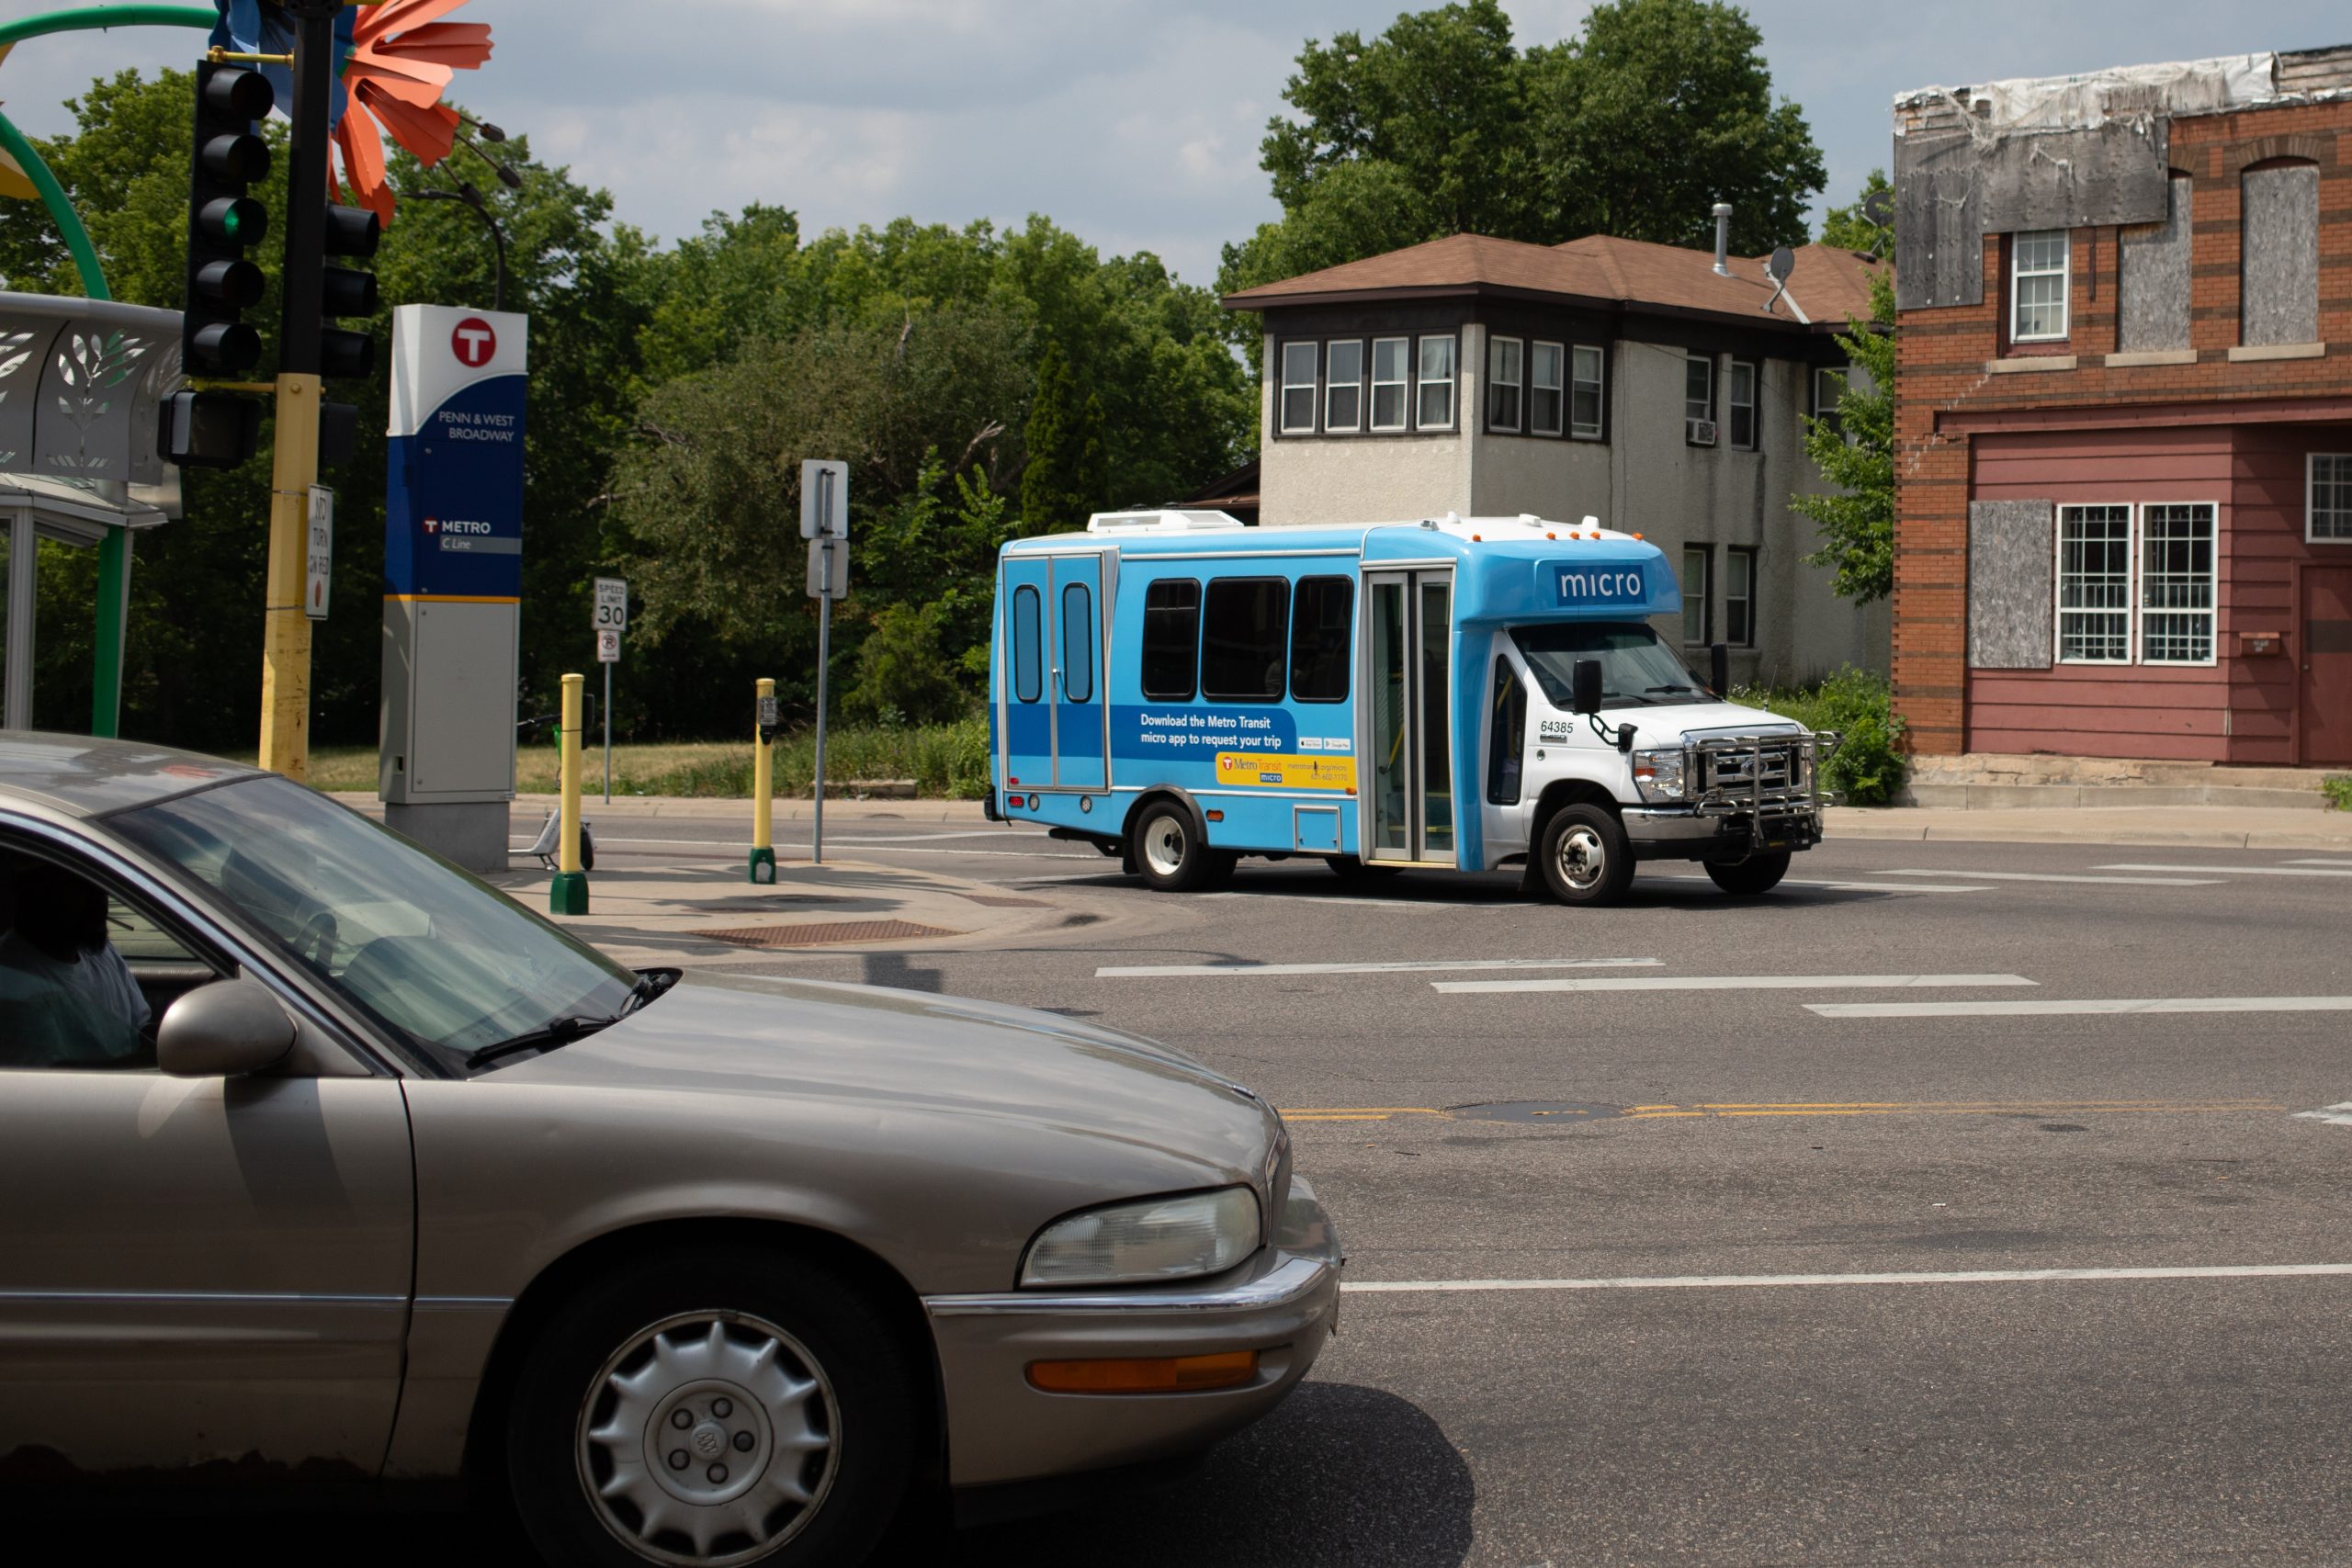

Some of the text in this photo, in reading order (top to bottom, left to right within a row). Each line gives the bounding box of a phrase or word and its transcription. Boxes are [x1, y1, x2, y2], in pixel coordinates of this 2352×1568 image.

[438, 411, 514, 427] PENN & WEST
[448, 427, 514, 442] BROADWAY
[315, 495, 326, 520] NO
[441, 520, 492, 534] METRO
[313, 527, 328, 547] TURN
[441, 537, 471, 549] C Line
[599, 583, 624, 594] SPEED
[1561, 573, 1641, 597] micro
[602, 594, 622, 604] LIMIT
[598, 605, 624, 625] 30
[1140, 714, 1271, 728] Download the Metro Transit
[1541, 720, 1574, 734] 64385
[1140, 731, 1282, 750] micro app to request your trip
[1261, 773, 1282, 782] micro
